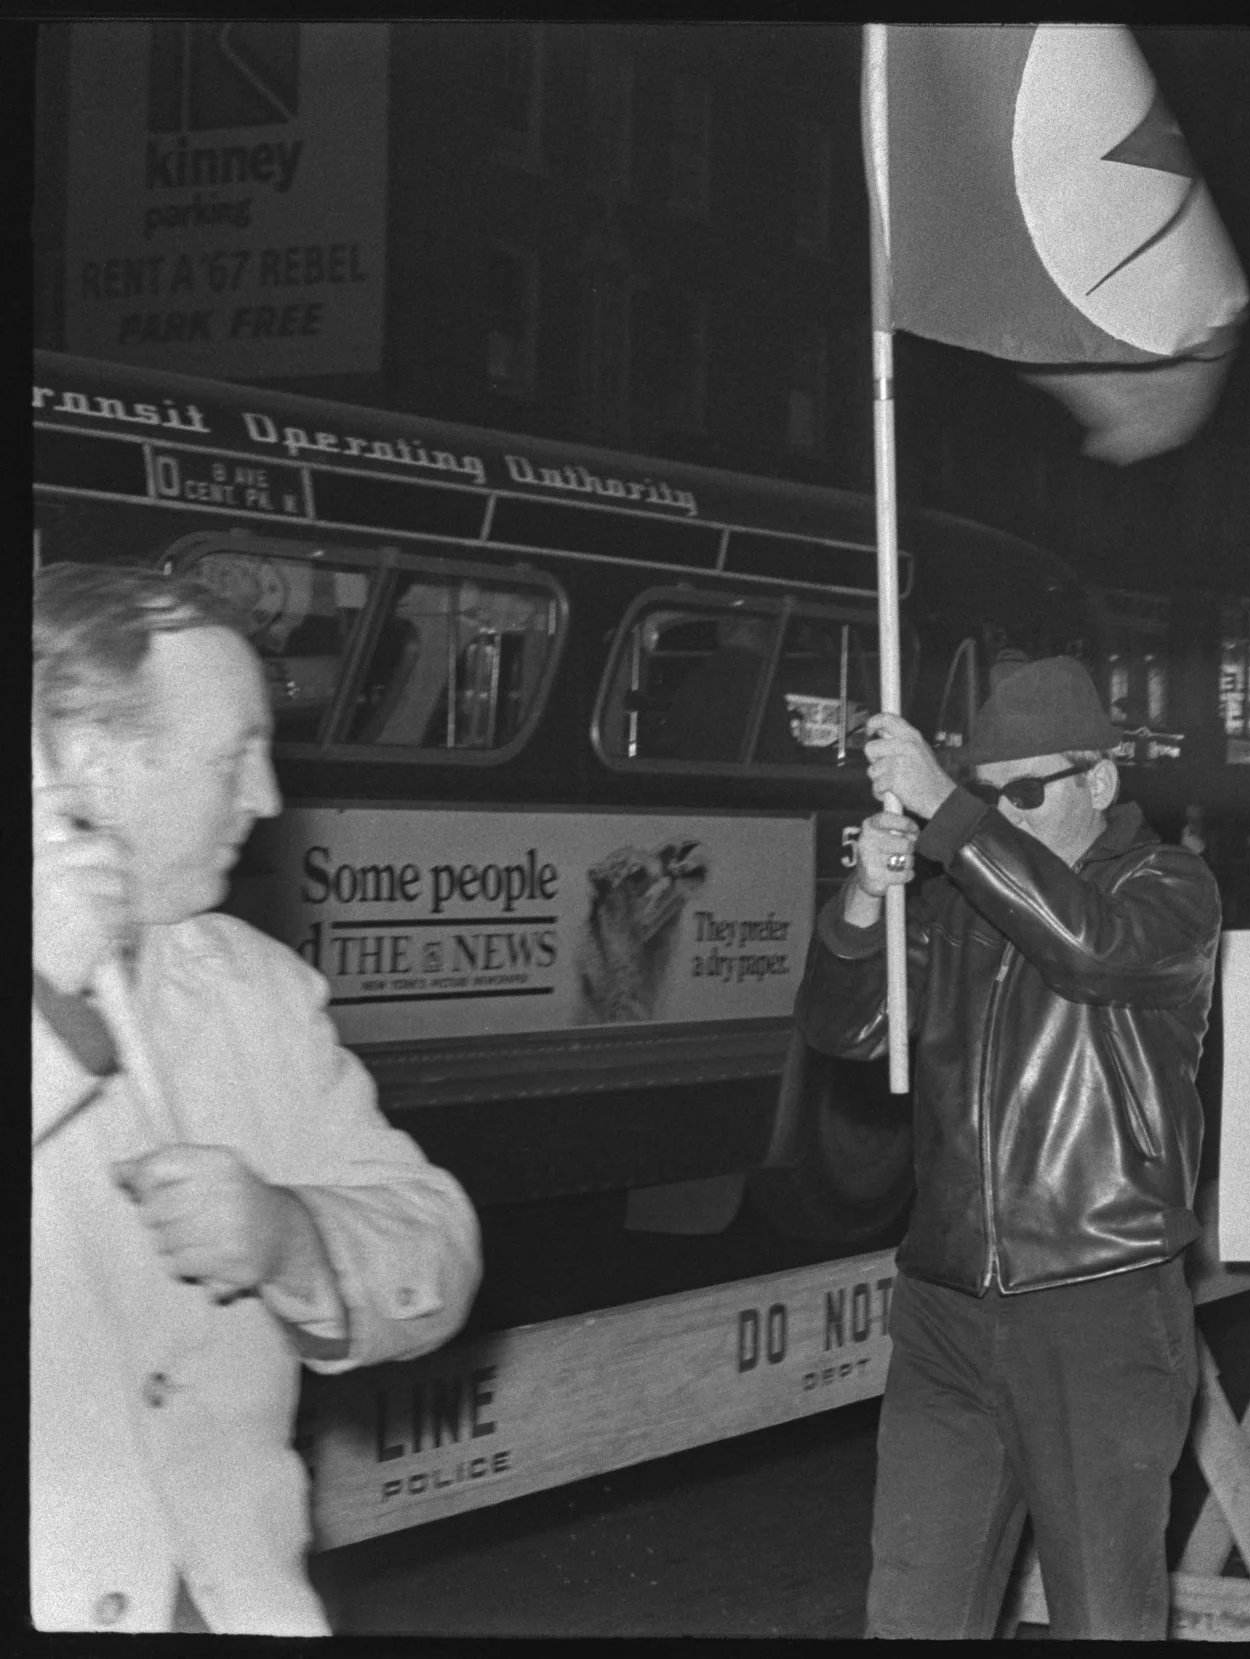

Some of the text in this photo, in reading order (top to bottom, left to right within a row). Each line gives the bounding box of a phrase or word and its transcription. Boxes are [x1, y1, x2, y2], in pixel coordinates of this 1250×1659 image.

[147, 133, 304, 193] kinney
[145, 192, 253, 241] parking
[81, 253, 165, 300] RENT
[169, 253, 196, 296] A
[258, 242, 367, 288] REBEL
[118, 302, 325, 346] PARK FREE
[32, 385, 699, 518] ransit Operating Authority
[302, 845, 560, 914] Some people
[331, 935, 413, 976] THE
[451, 930, 558, 973] NEWS
[692, 911, 736, 948] They
[378, 1365, 500, 1462] LINE
[737, 1302, 789, 1374] DO
[824, 1276, 894, 1352] NOT
[380, 1450, 513, 1503] POLICE
